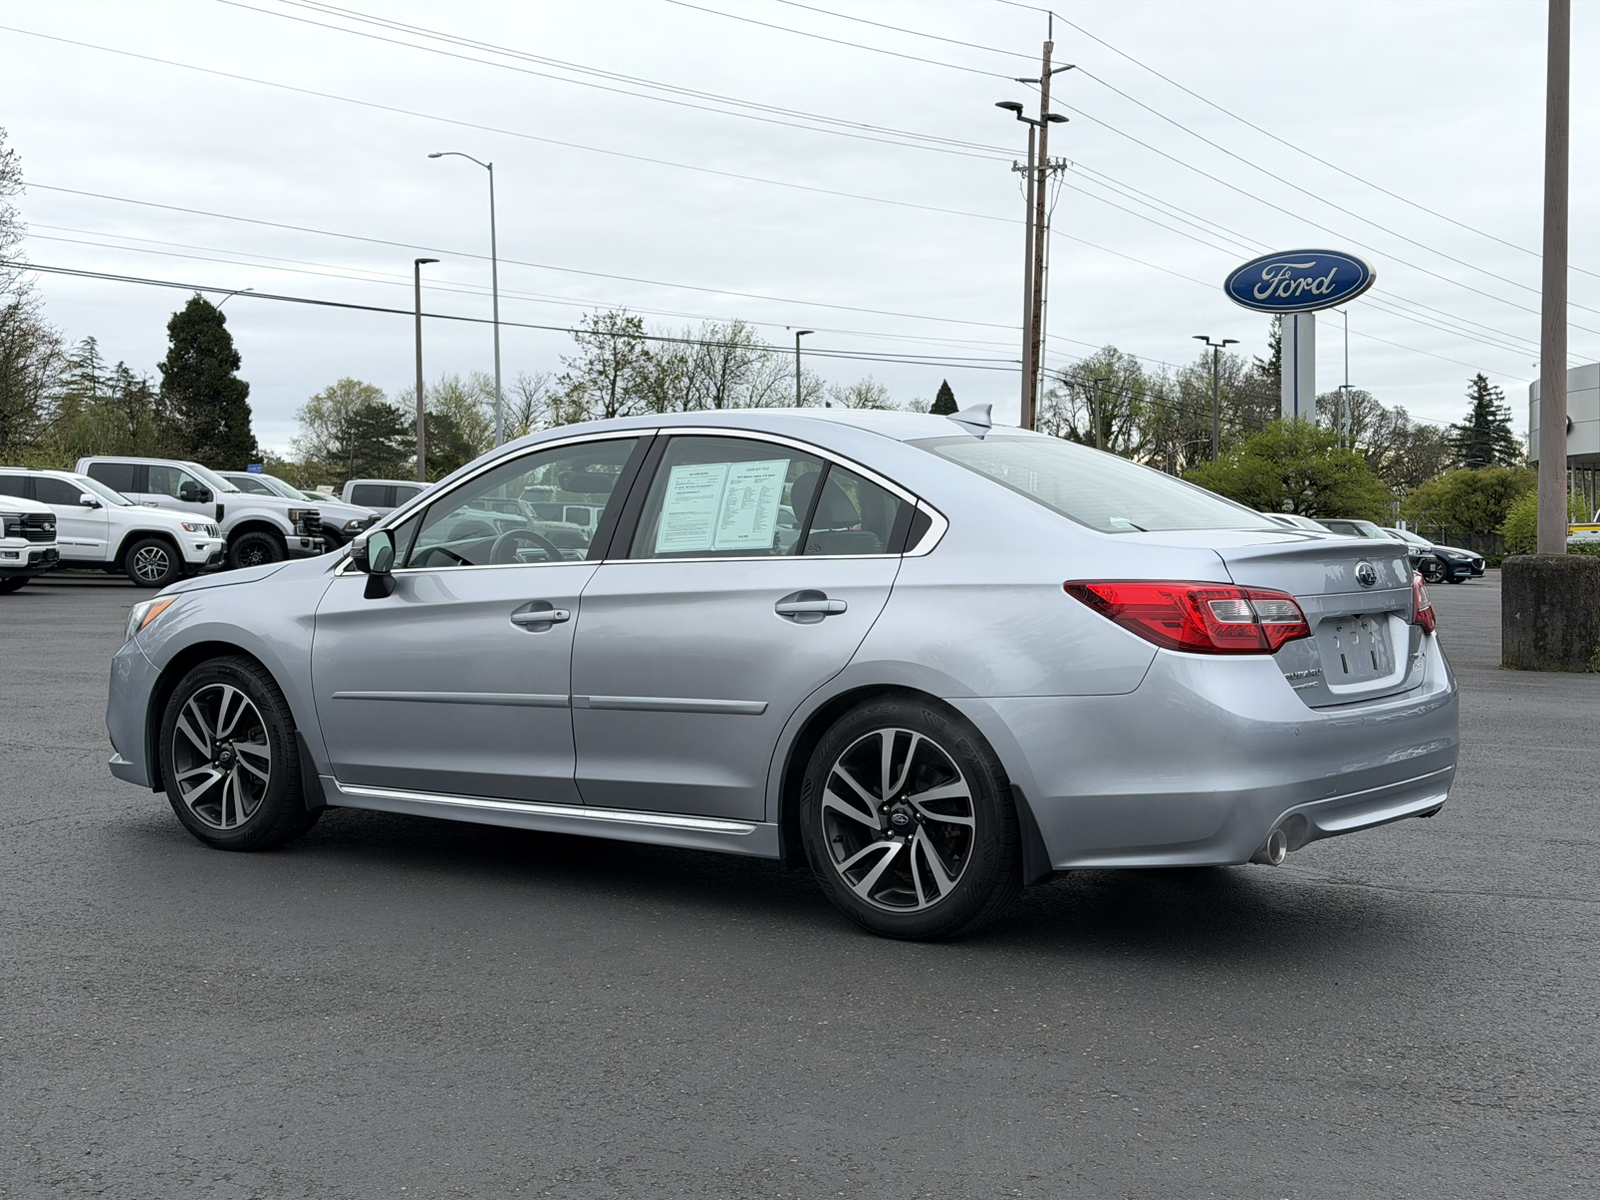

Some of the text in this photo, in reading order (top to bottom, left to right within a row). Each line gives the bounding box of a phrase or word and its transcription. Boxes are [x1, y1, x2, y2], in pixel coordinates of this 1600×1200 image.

[1253, 261, 1338, 300] Ford
[1284, 668, 1322, 679] SUBARU
[845, 705, 903, 723] NEXEN
